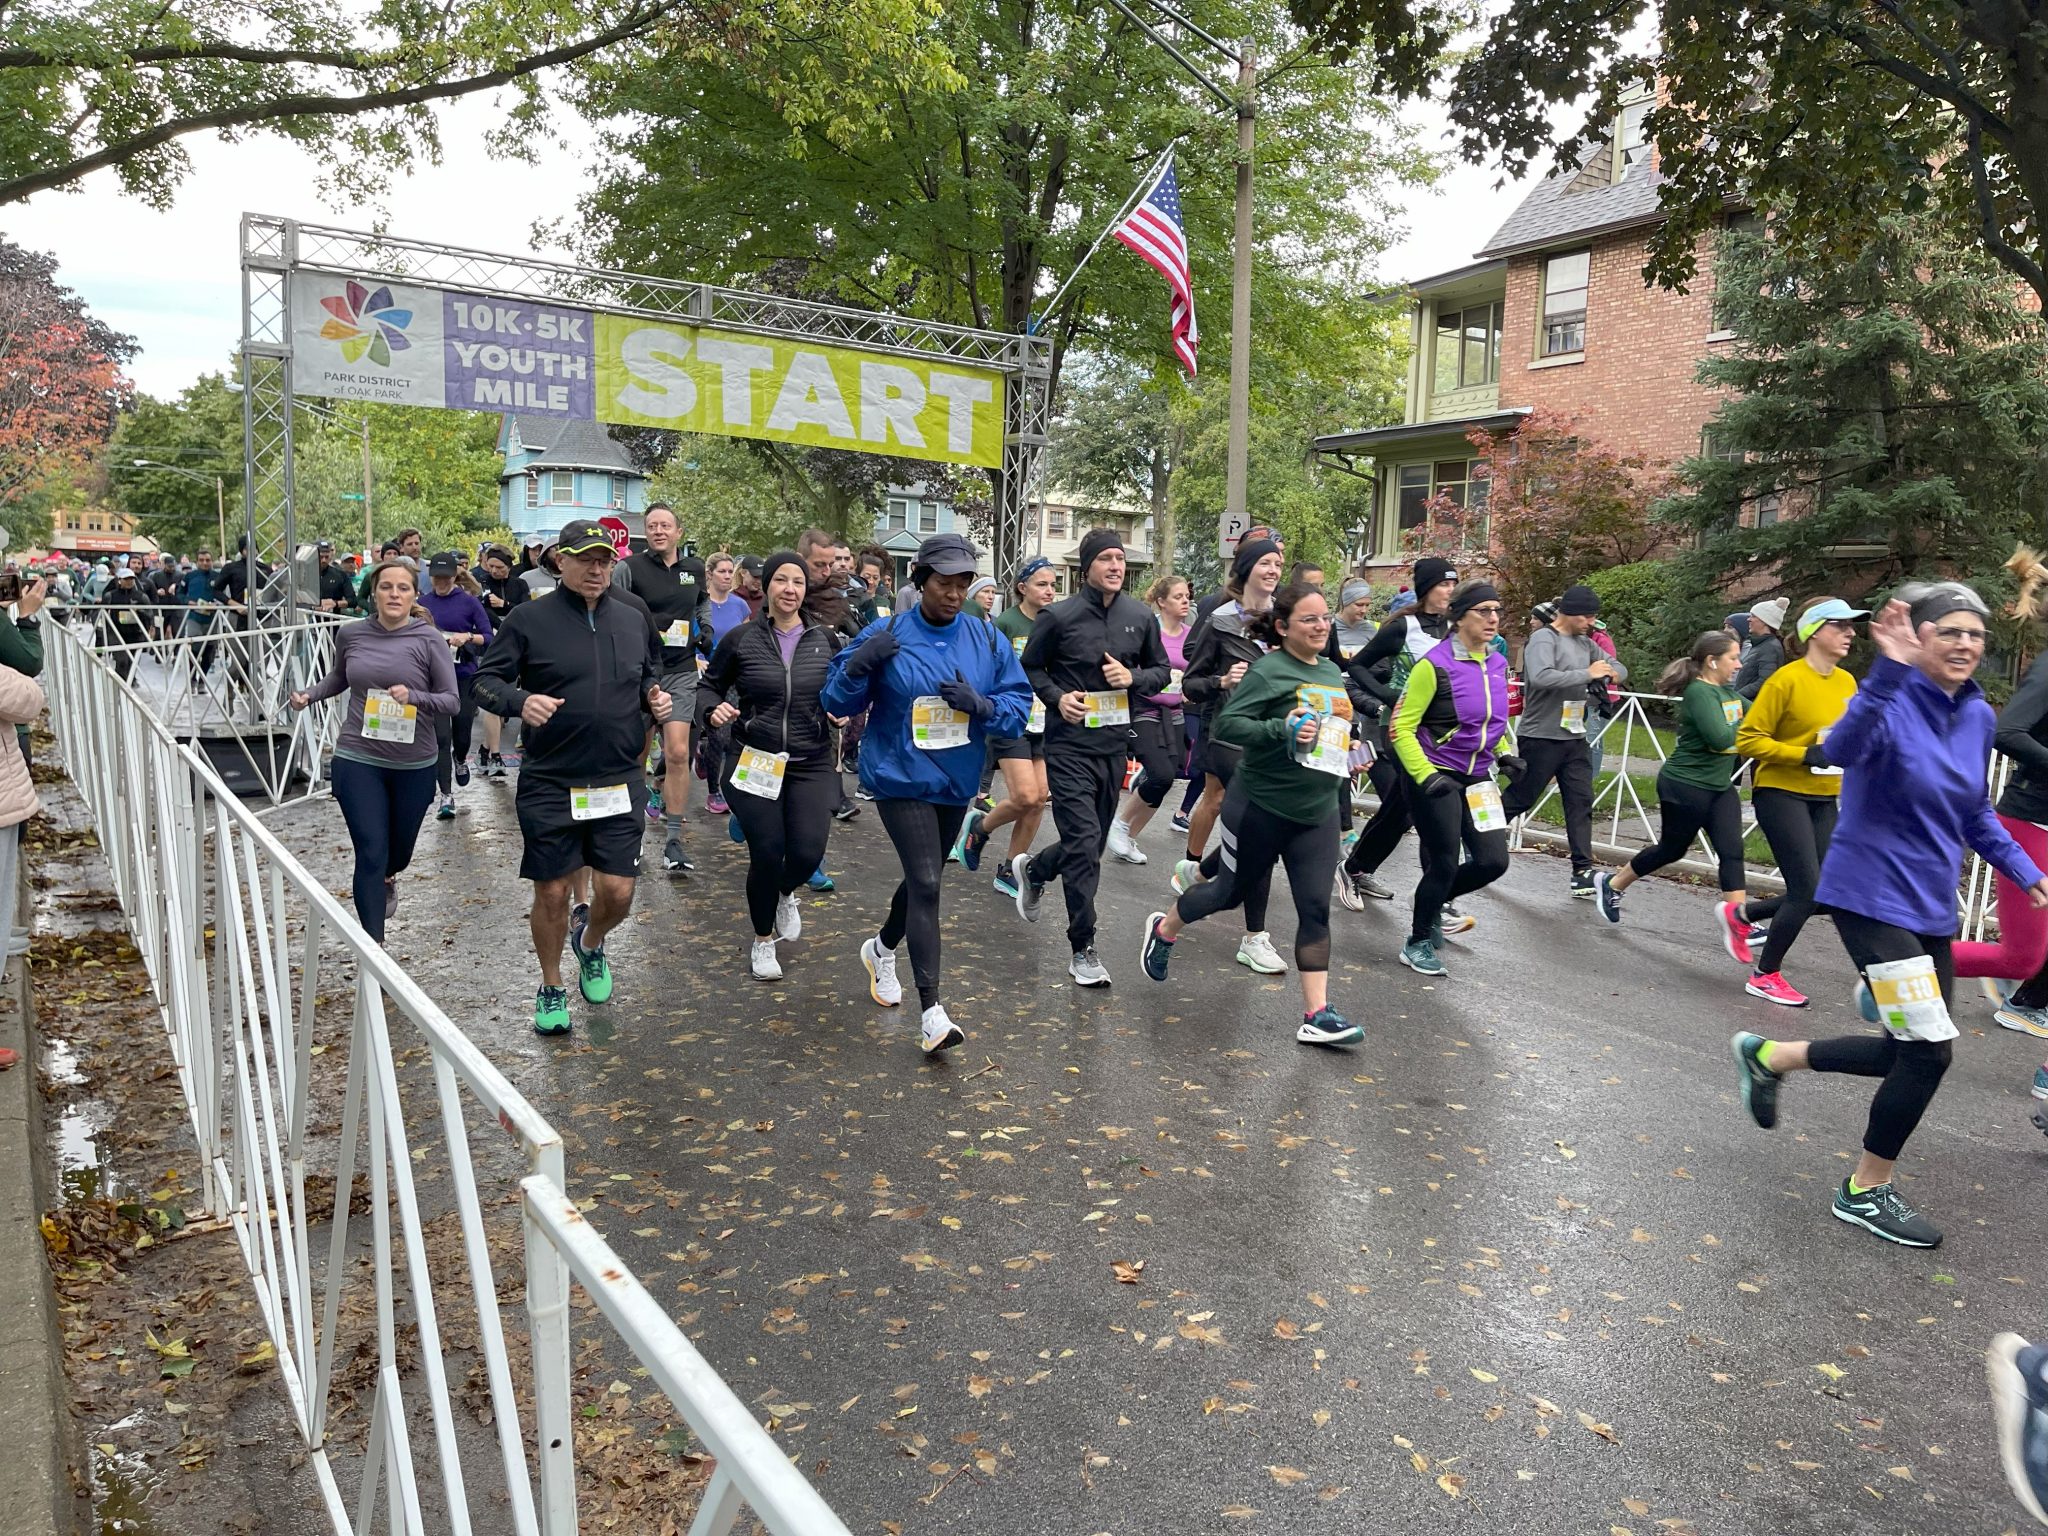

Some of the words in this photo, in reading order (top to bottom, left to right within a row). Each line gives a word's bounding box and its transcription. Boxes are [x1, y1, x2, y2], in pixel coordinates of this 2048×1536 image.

[452, 341, 586, 380] YOUTH
[324, 371, 355, 384] PARK
[358, 375, 412, 388] DISTRICT
[334, 385, 345, 394] of
[347, 386, 372, 397] OAK
[375, 388, 403, 400] PARK
[474, 378, 569, 411] MILE
[616, 328, 993, 454] START
[610, 528, 627, 543] OP
[378, 701, 405, 718] 605
[930, 708, 954, 723] 129
